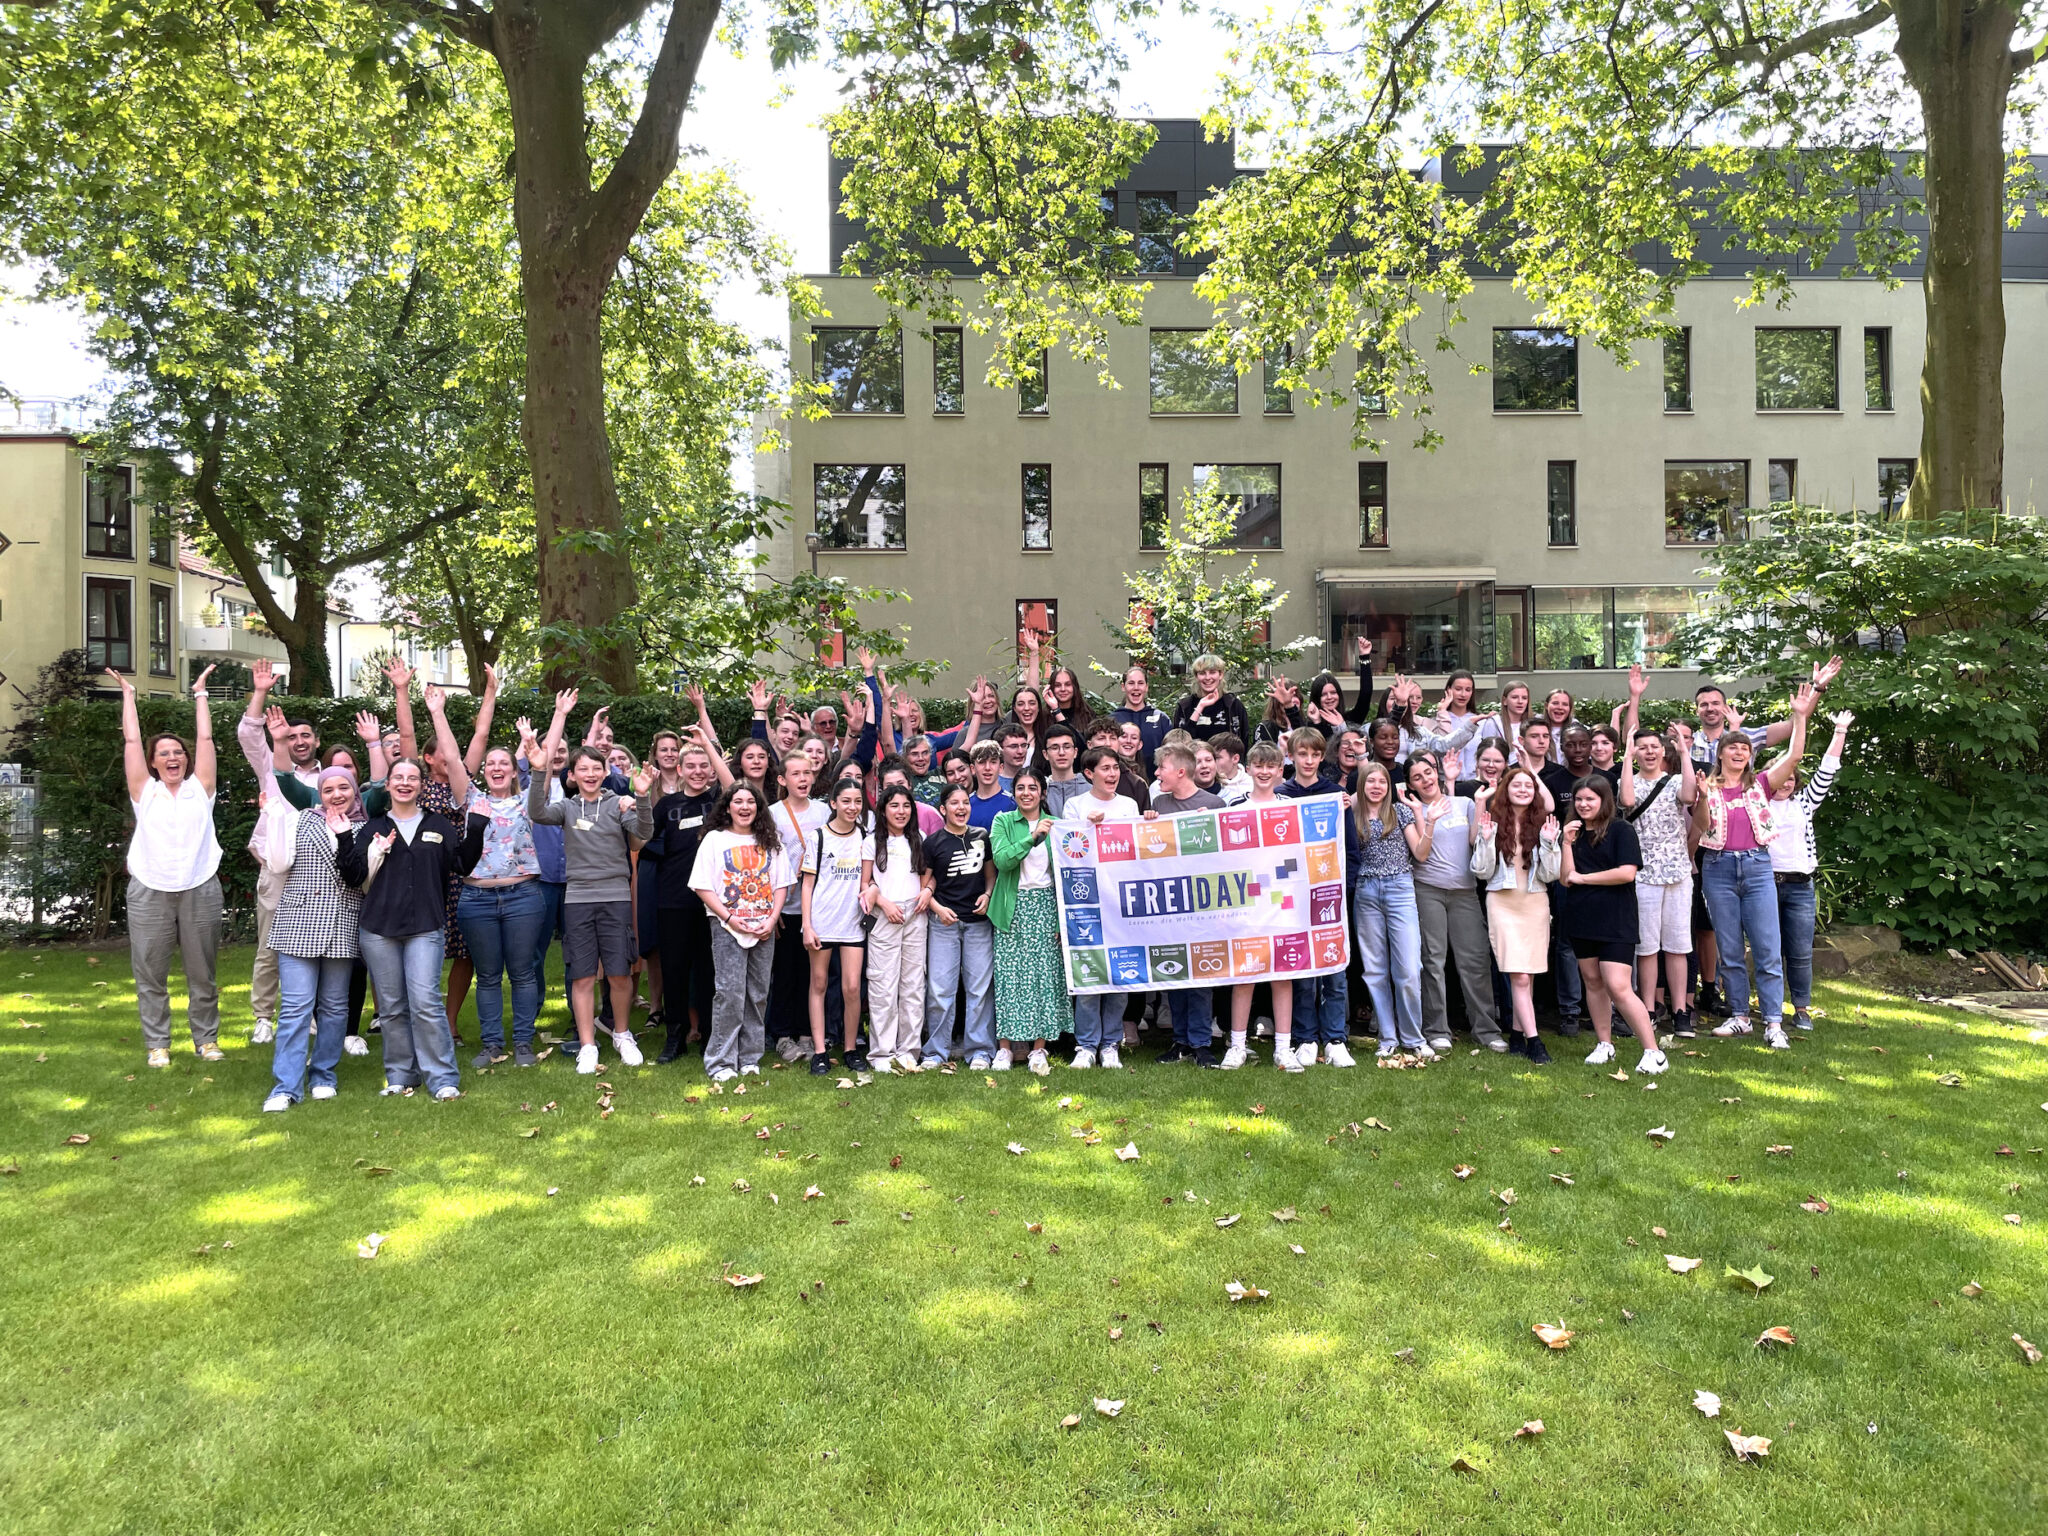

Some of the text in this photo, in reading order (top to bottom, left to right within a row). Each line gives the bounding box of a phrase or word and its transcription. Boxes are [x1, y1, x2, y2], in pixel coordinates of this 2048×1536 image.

[1263, 811, 1269, 820] 5
[1304, 807, 1309, 816] 6
[1222, 815, 1228, 824] 4
[1181, 821, 1186, 829] 3
[1063, 870, 1070, 879] 17
[1125, 872, 1247, 916] FREIDAY
[1067, 911, 1075, 920] 16
[1315, 932, 1320, 942] 9
[1234, 942, 1241, 950] 11
[1276, 938, 1284, 946] 10
[1151, 948, 1159, 957] 13
[1192, 945, 1201, 954] 12
[1072, 952, 1080, 961] 15
[1111, 951, 1119, 959] 14
